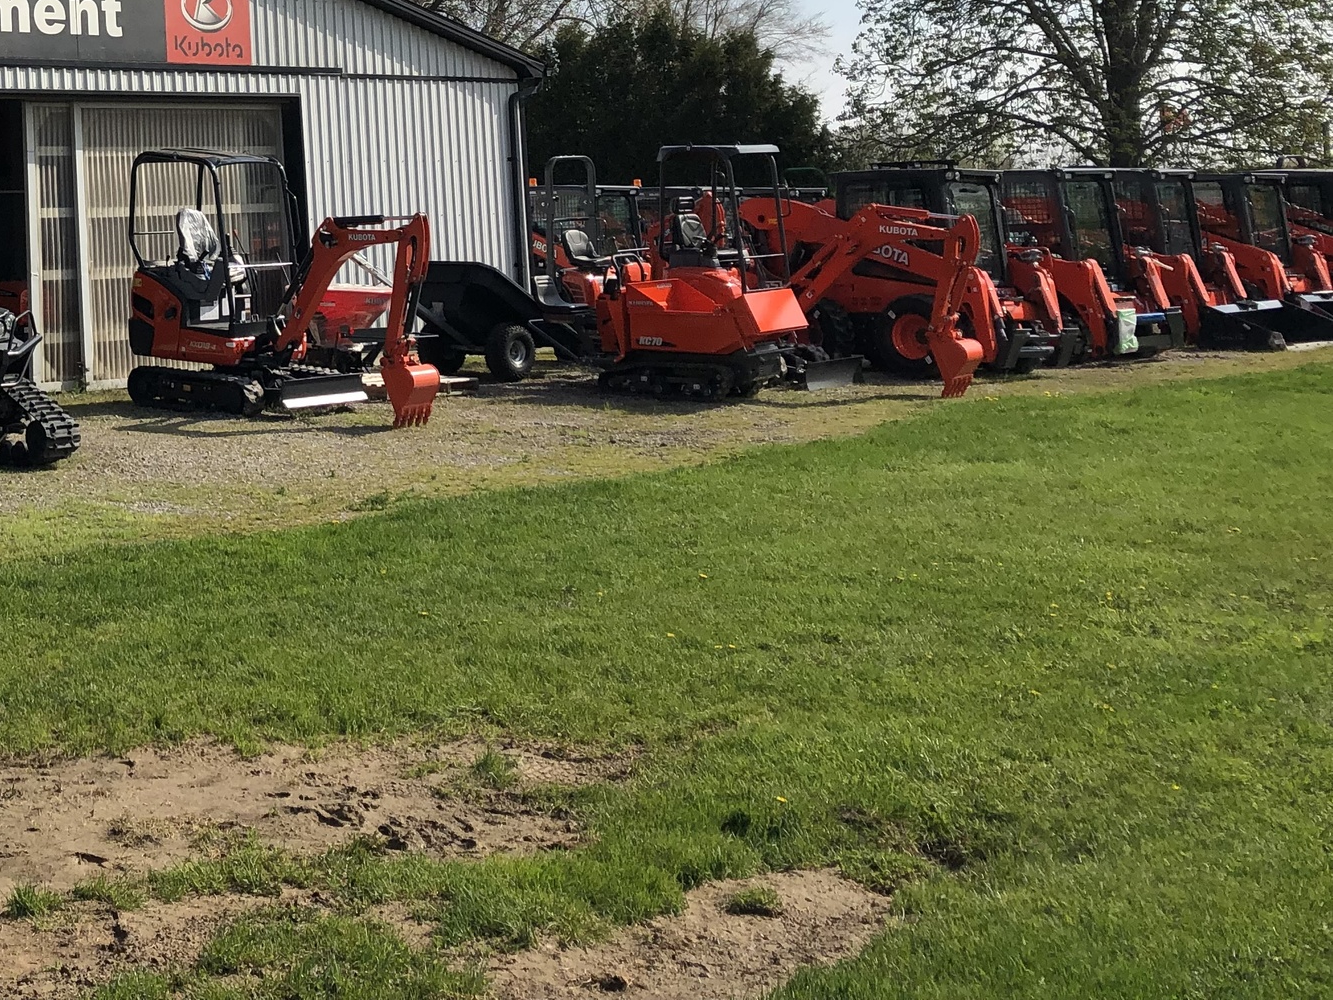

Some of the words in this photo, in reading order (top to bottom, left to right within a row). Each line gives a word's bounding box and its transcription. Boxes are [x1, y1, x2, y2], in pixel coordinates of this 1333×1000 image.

[174, 35, 243, 58] Kubota
[879, 225, 919, 236] KUBOTA
[348, 233, 376, 241] KUBOTA
[871, 245, 909, 266] OTA
[639, 336, 663, 346] KC70
